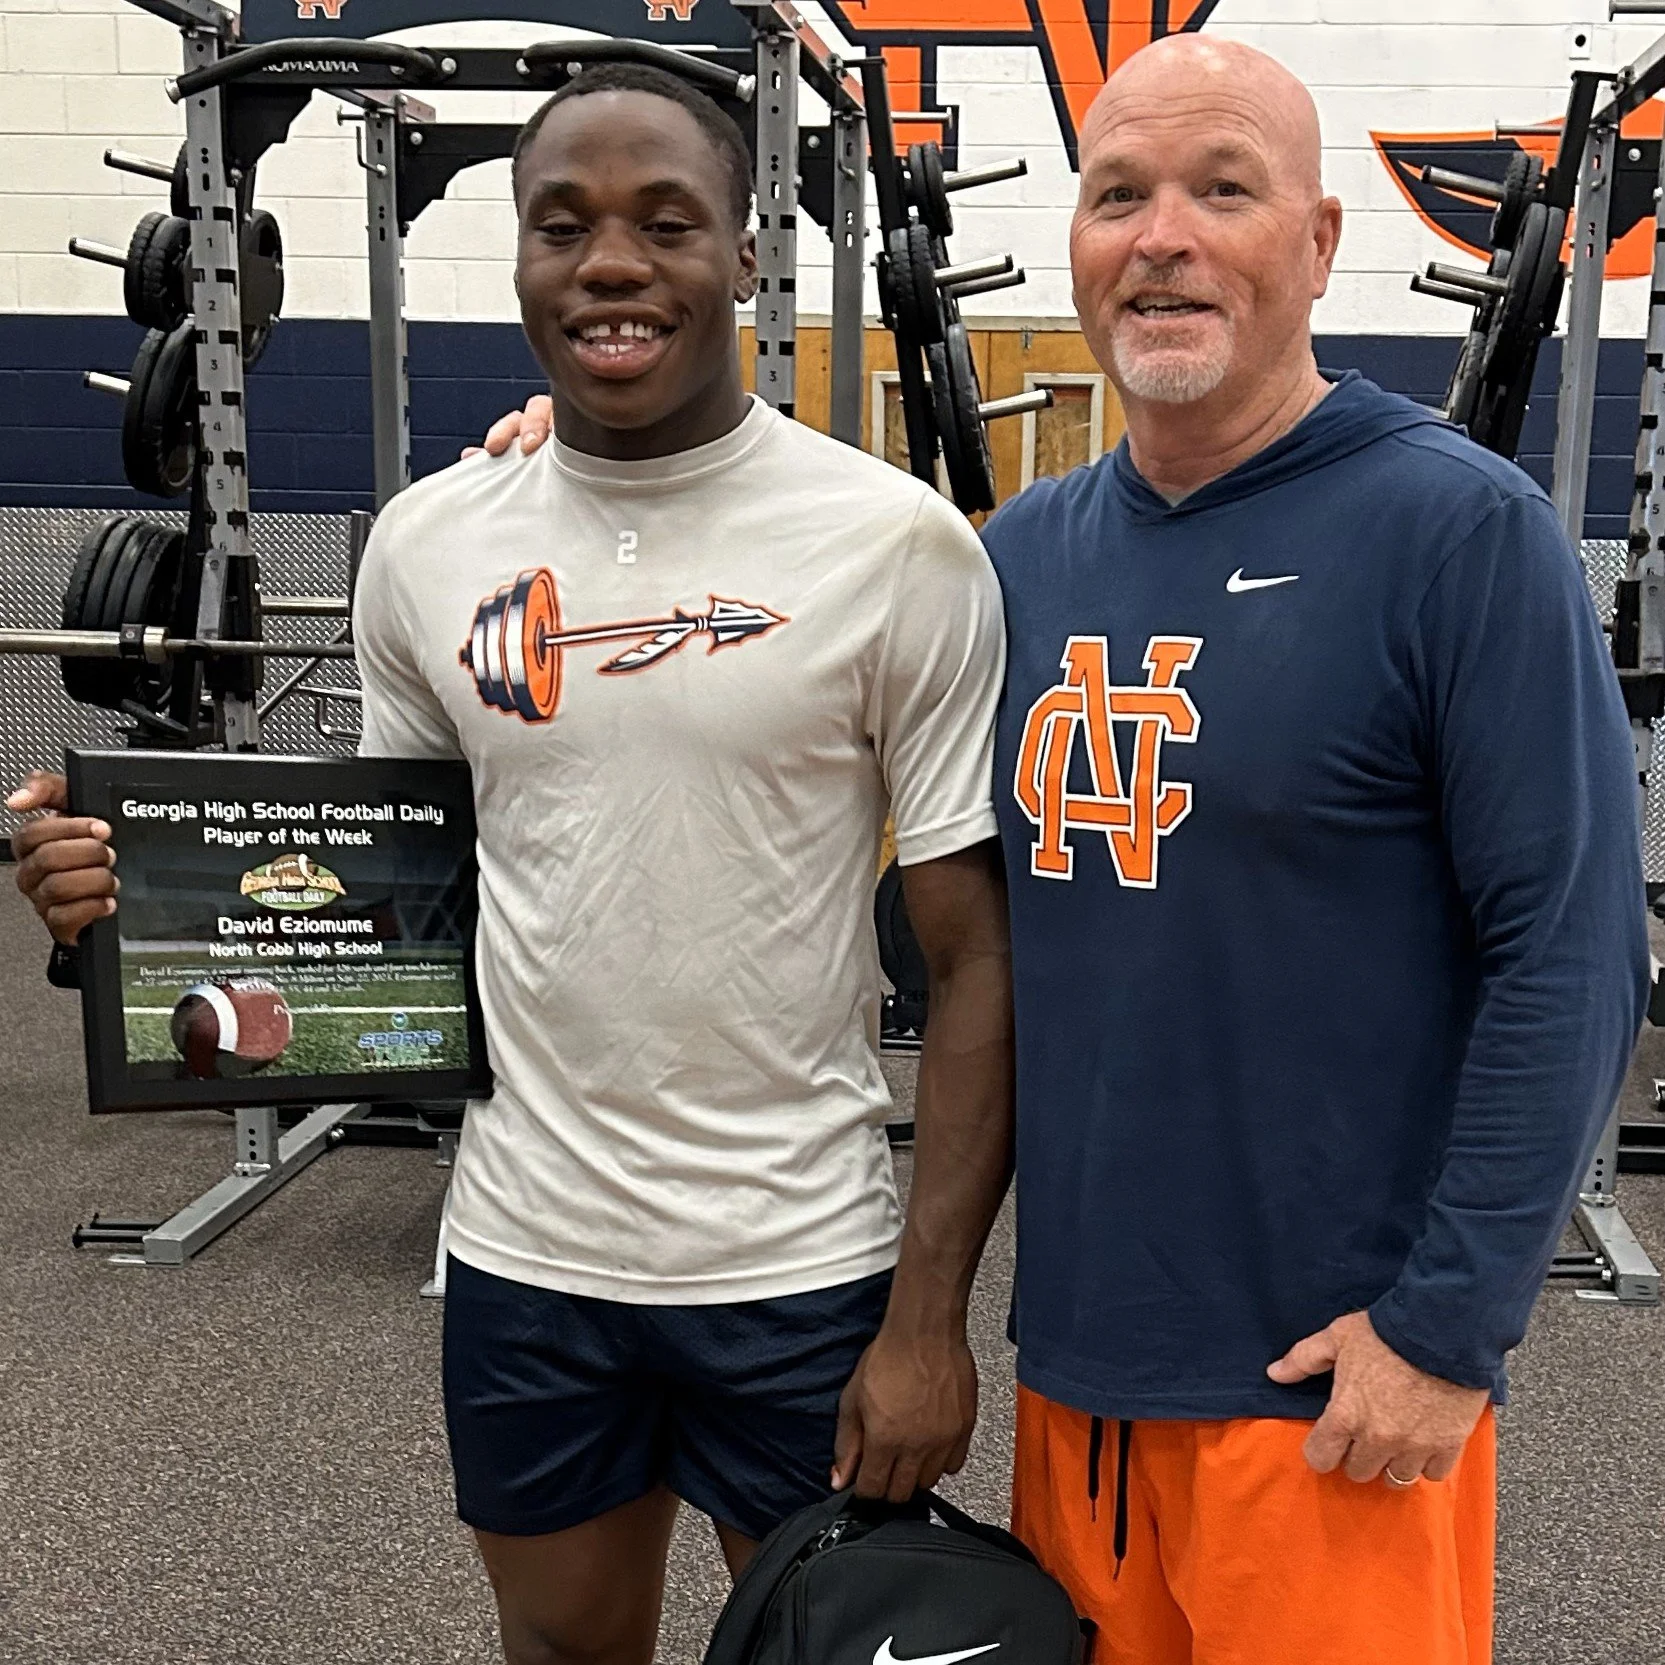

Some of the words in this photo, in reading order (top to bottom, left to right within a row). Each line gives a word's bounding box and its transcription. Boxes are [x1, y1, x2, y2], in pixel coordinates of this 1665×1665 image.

[206, 237, 213, 247] 1
[771, 246, 778, 257] 1
[208, 300, 216, 311] 2
[769, 310, 778, 321] 2
[210, 359, 218, 370] 3
[769, 370, 777, 382] 3
[213, 422, 222, 432] 4
[217, 479, 224, 490] 5
[1652, 503, 1660, 515] 5
[617, 530, 638, 564] 2
[121, 800, 198, 822] Georgia
[203, 800, 247, 823] High
[252, 802, 315, 820] School
[321, 803, 394, 821] Football
[400, 804, 444, 825] Daily
[203, 827, 263, 847] Player
[268, 828, 287, 845] of
[292, 828, 321, 845] the
[325, 828, 374, 845] Week
[217, 916, 274, 935] David
[279, 916, 374, 934] Eziomume
[209, 942, 252, 957] North
[256, 941, 295, 957] Cobb
[299, 941, 331, 959] High
[334, 941, 383, 956] School
